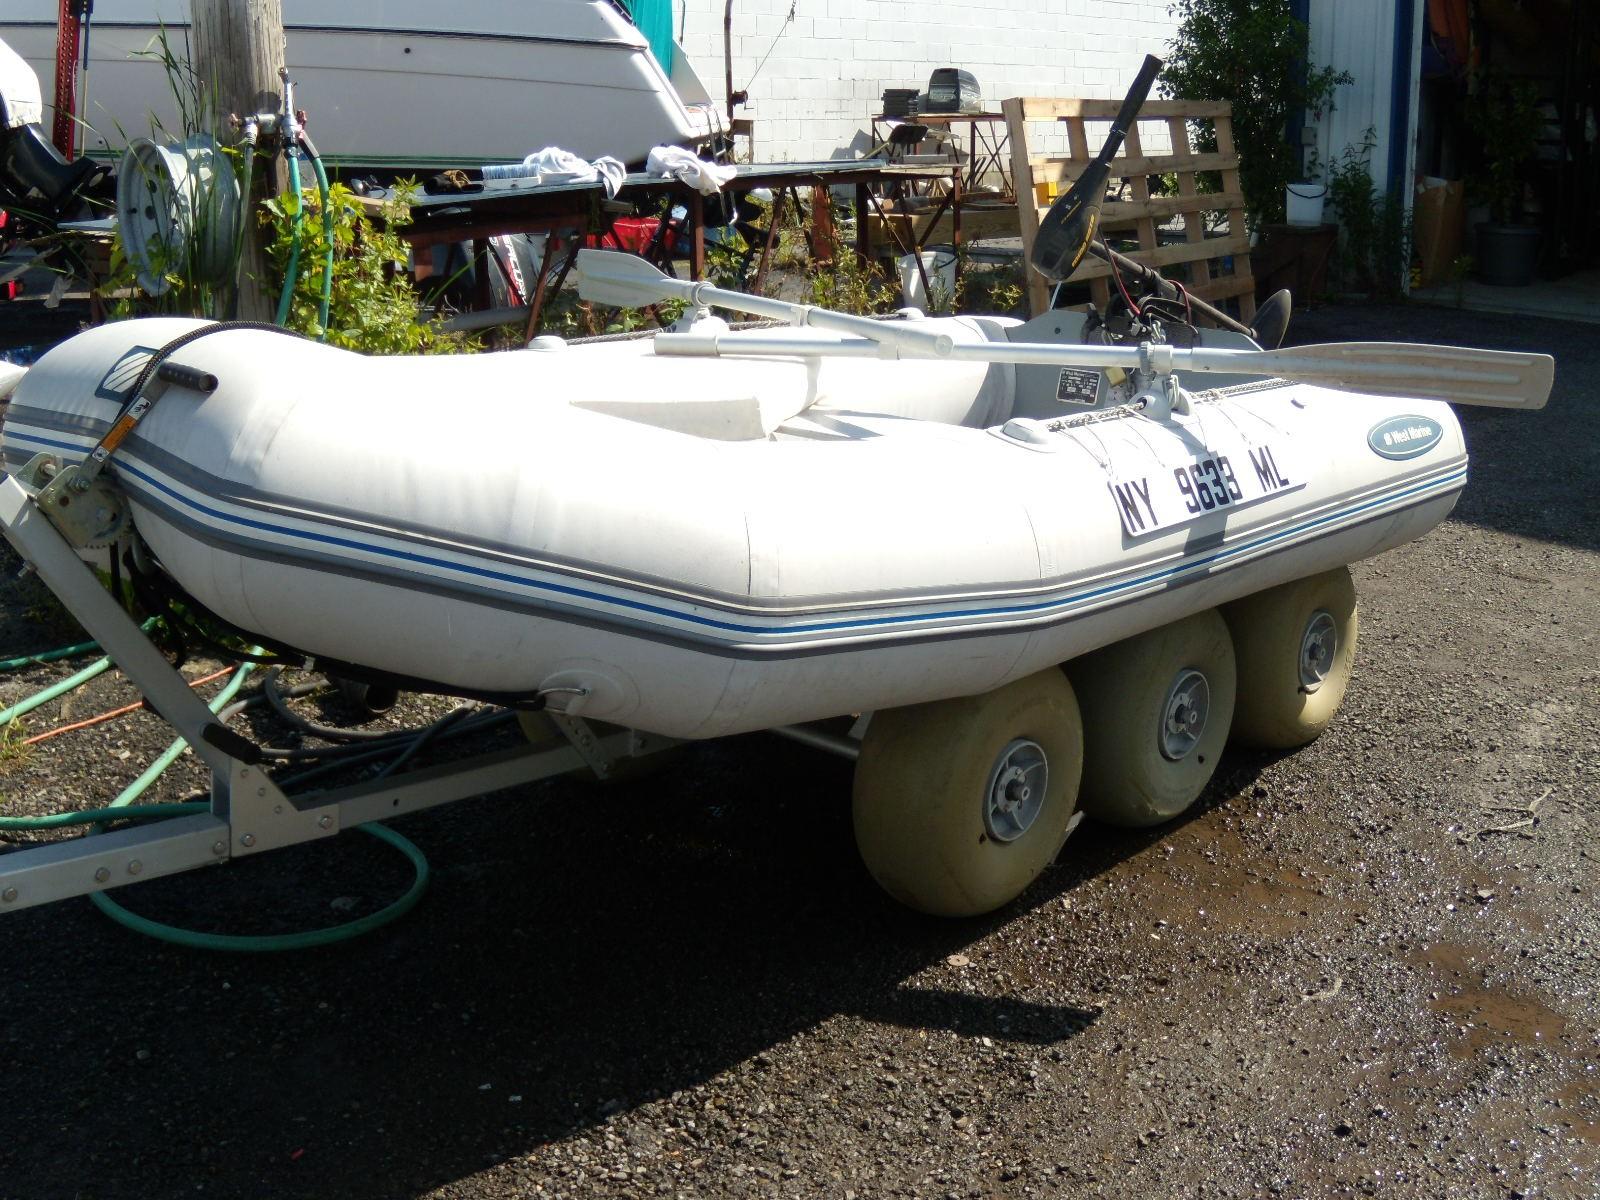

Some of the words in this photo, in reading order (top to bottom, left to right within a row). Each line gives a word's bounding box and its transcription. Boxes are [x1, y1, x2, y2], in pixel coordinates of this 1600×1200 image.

[1391, 428, 1410, 444] West
[1408, 425, 1432, 440] Marine
[1115, 477, 1158, 533] NY
[1173, 455, 1243, 514] 9633
[1248, 445, 1290, 493] ML
